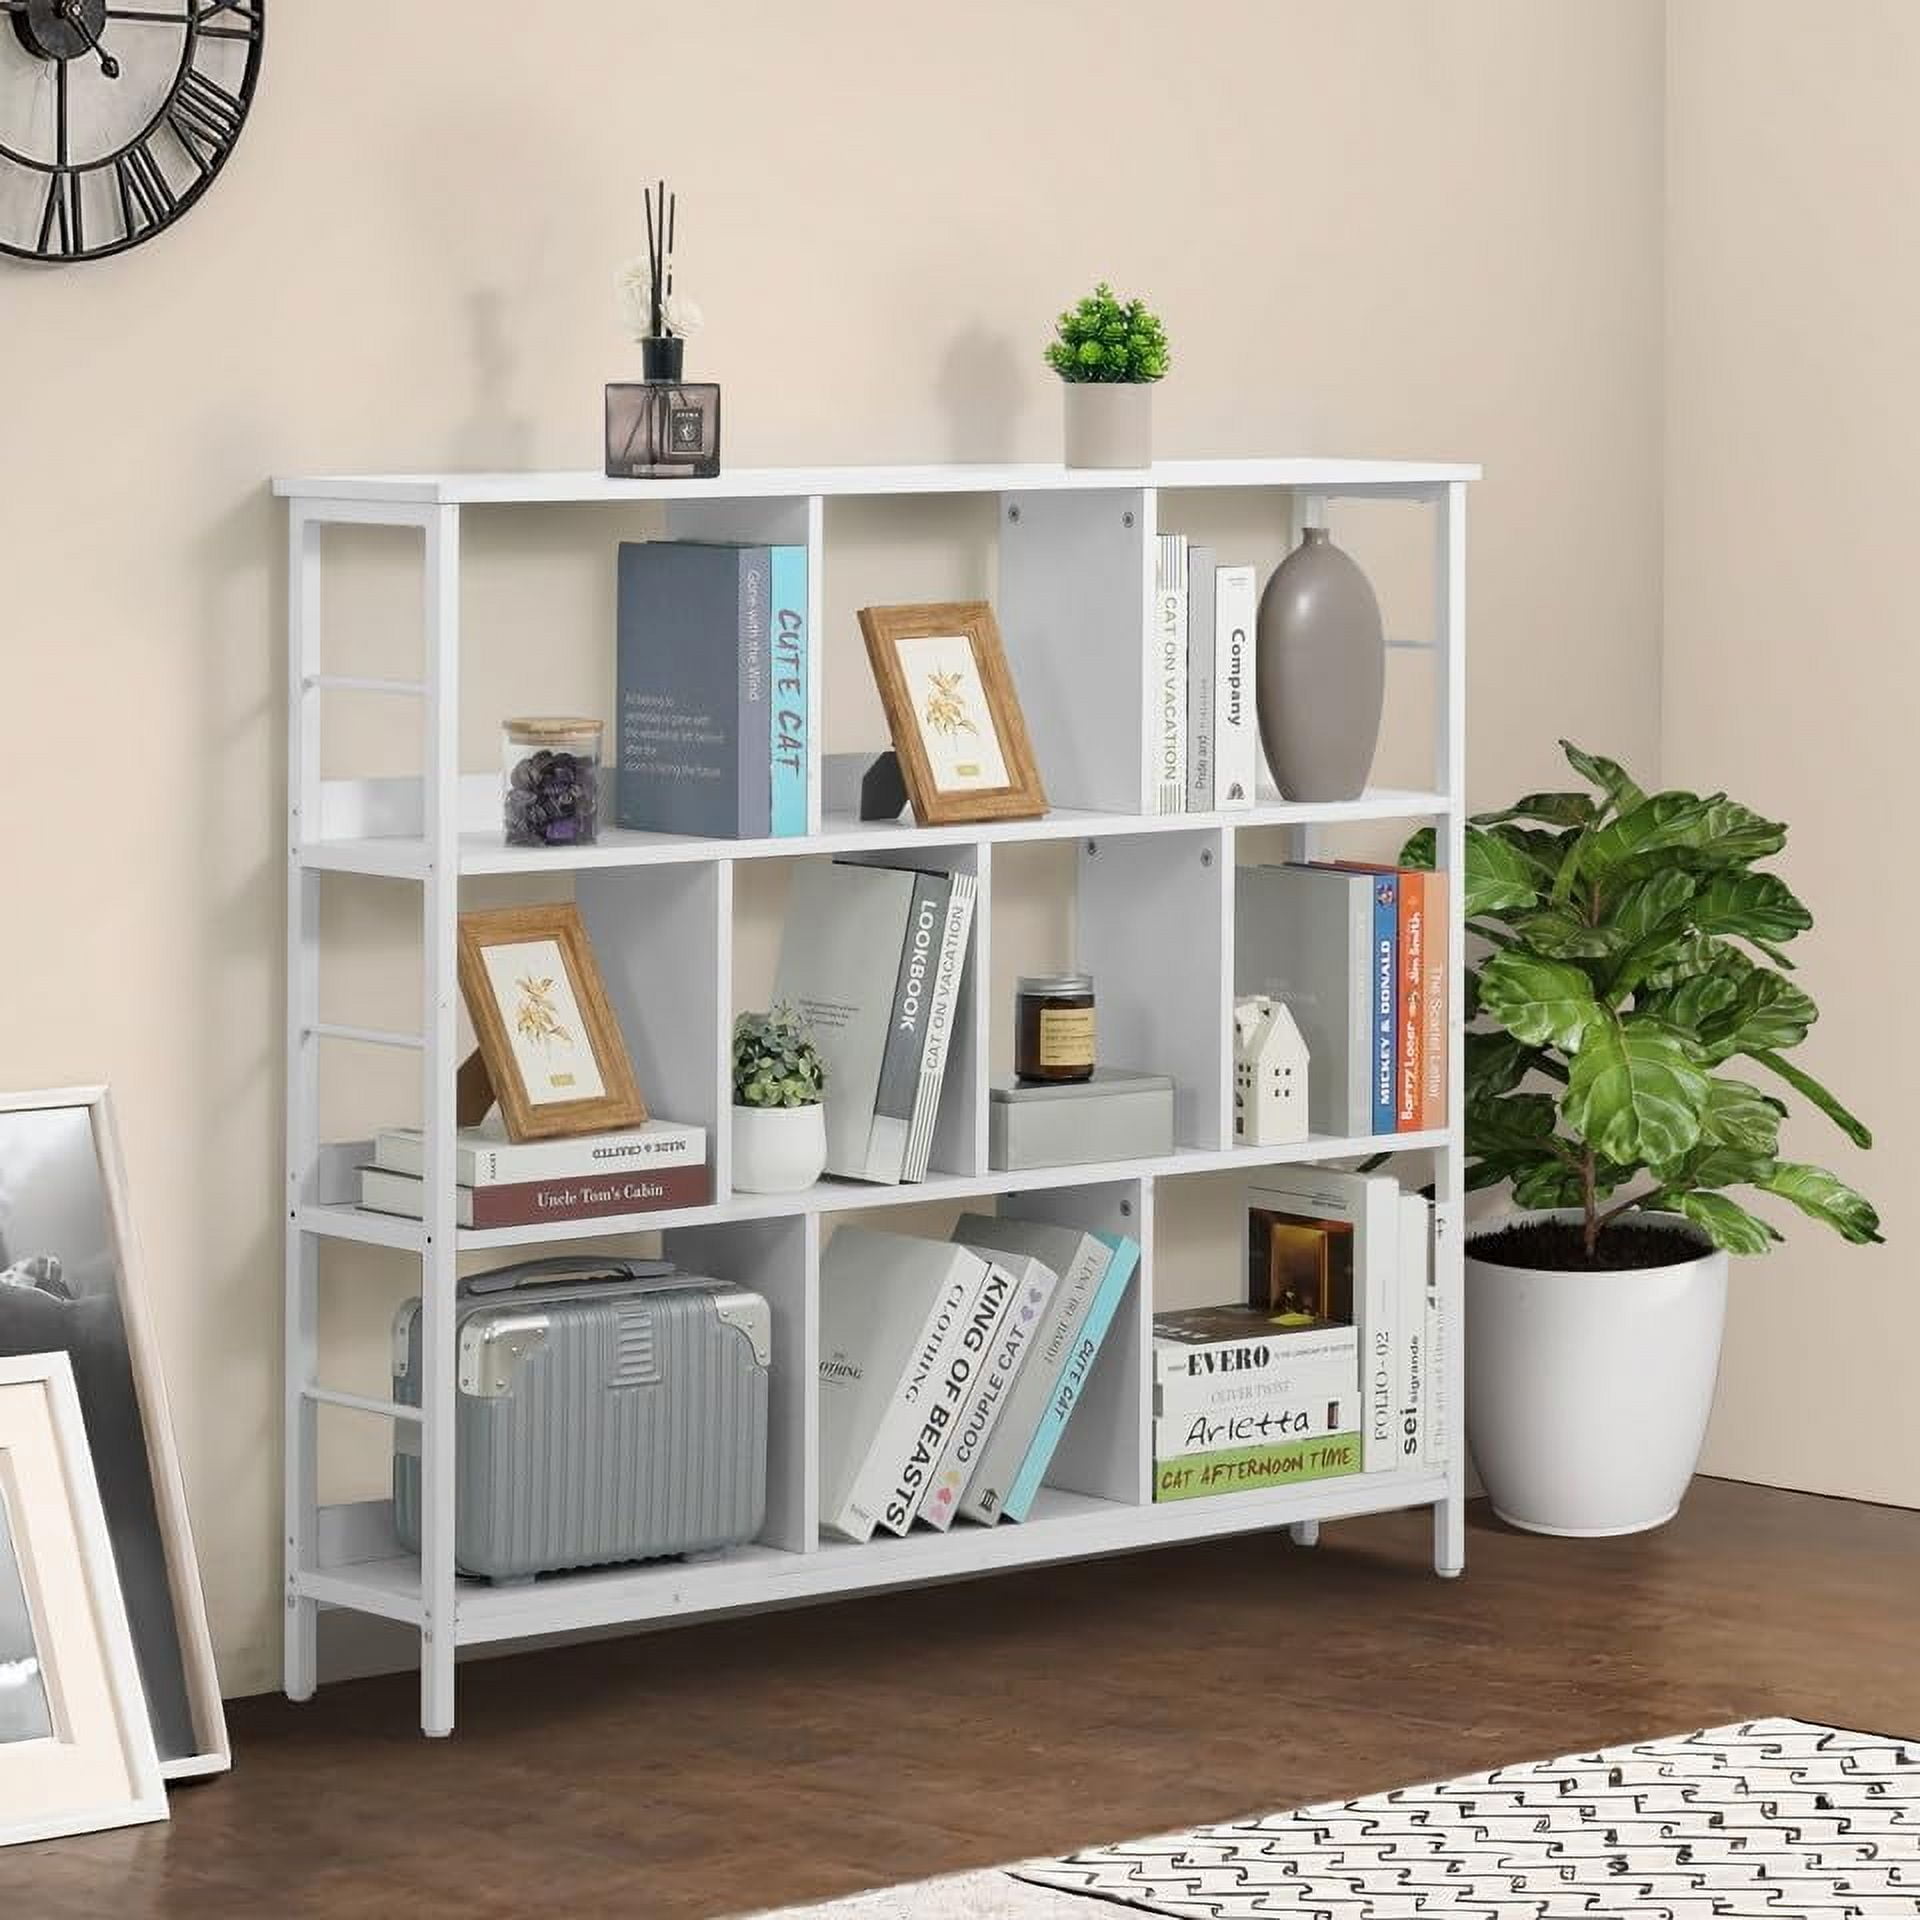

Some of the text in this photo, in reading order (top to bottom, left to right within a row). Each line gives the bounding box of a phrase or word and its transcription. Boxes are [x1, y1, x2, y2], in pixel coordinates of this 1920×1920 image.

[776, 608, 803, 779] CUTE CAT
[1164, 596, 1178, 781] CAT ON VACATION
[1227, 628, 1246, 727] Company
[899, 899, 937, 1032] LOOKBOOK
[926, 907, 965, 1069] CAT ON VACATION
[1380, 940, 1391, 1105] MICKEY & DONALD
[1404, 1021, 1416, 1067] Loser
[1400, 1069, 1415, 1121] Barry
[537, 1183, 664, 1208] Uncle Tom's Cabin
[904, 1283, 964, 1404] CLOTHING
[1068, 1339, 1095, 1385] CUTE
[1187, 1345, 1270, 1377] EVERO
[885, 1275, 1008, 1526] KING OF BEASTS
[956, 1323, 1026, 1463] COUPLE CAT
[1053, 1386, 1074, 1422] CAT
[1185, 1410, 1310, 1447] Arletta
[1161, 1446, 1352, 1489] CAT AFTERNOON TIME
[1400, 1407, 1418, 1456] sei
